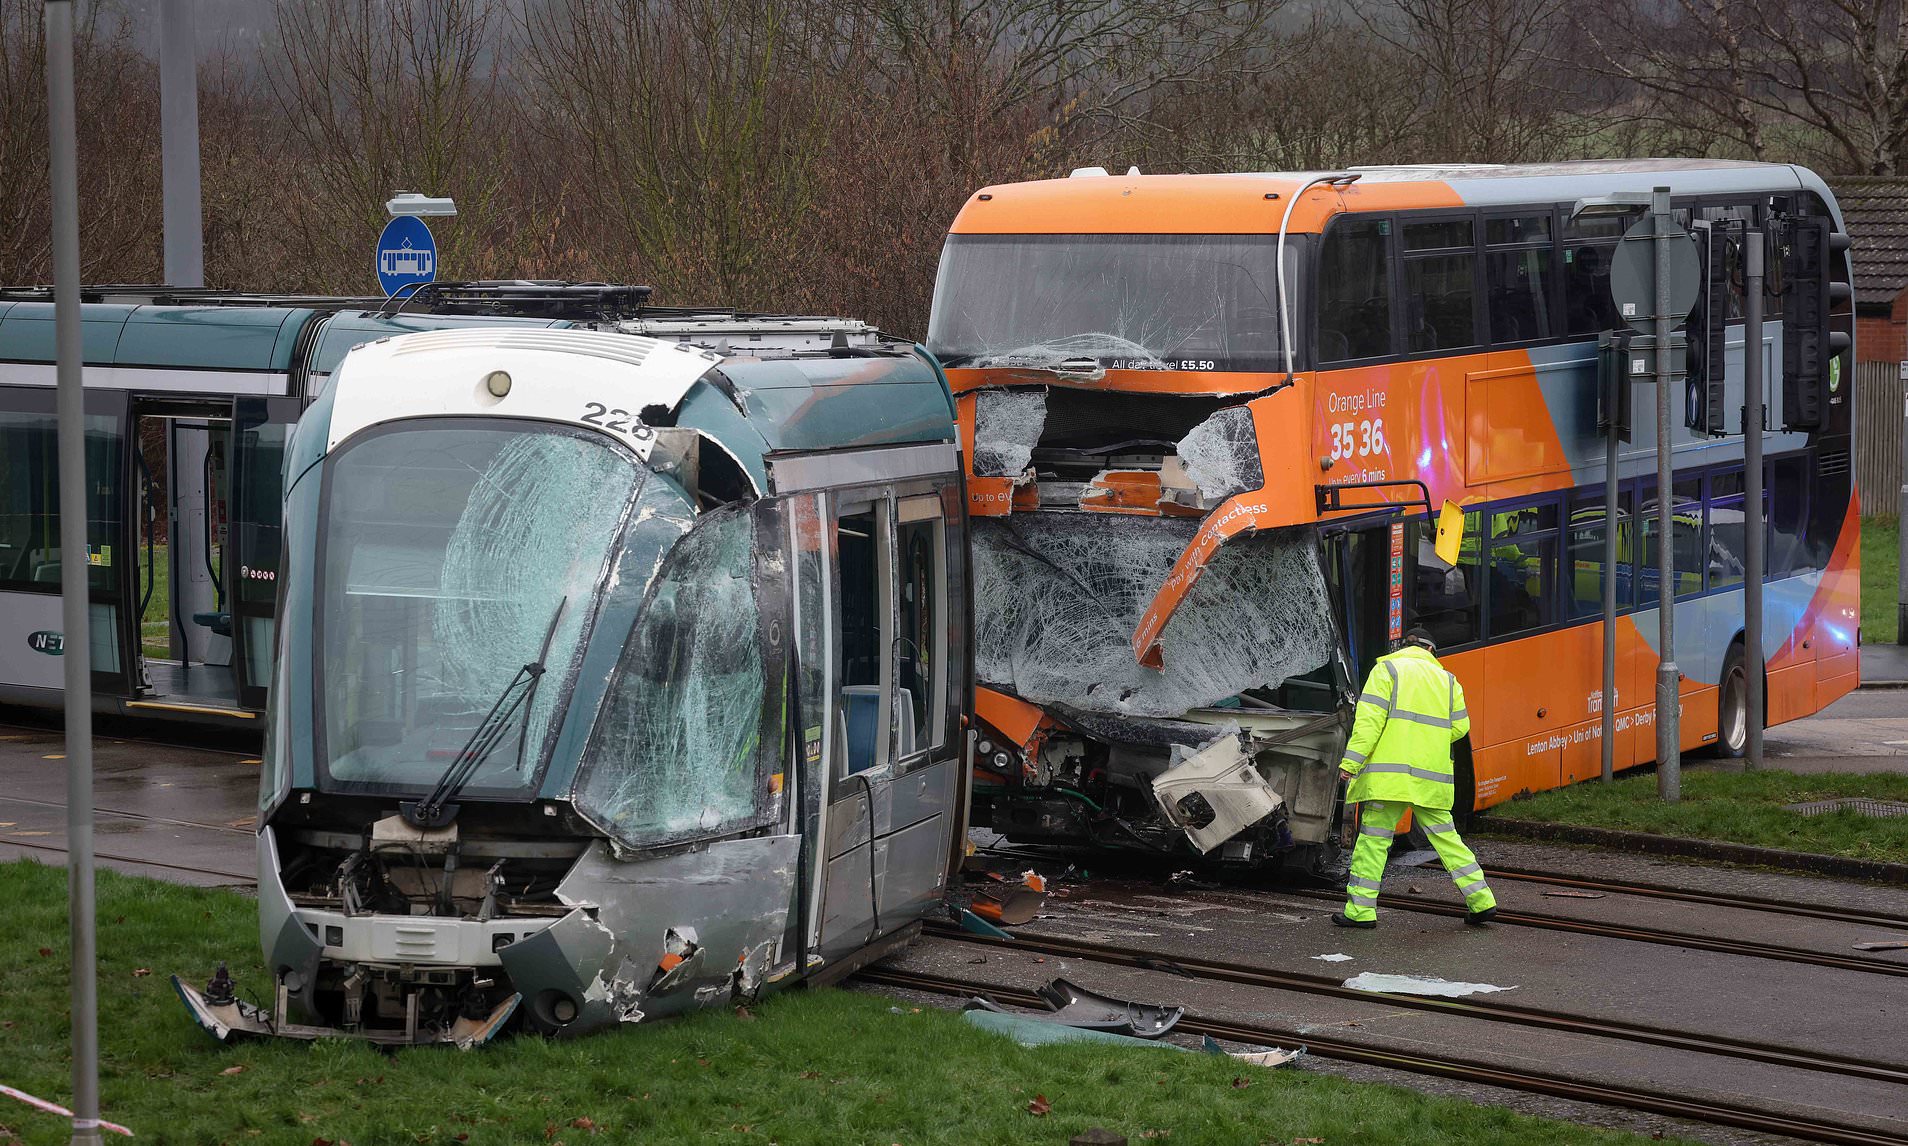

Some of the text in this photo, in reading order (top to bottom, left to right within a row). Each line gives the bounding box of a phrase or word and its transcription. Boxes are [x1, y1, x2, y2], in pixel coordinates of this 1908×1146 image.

[1111, 359, 1126, 369] All
[1181, 360, 1215, 370] £5.50
[1328, 388, 1386, 416] Orange Line
[580, 402, 654, 441] 228
[1330, 418, 1384, 461] 35 36
[1343, 473, 1361, 484] every
[1362, 468, 1367, 483] 6
[1368, 466, 1386, 482] mins
[986, 493, 995, 502] to
[1141, 613, 1158, 640] mins
[1184, 544, 1202, 571] with
[1201, 503, 1268, 546] Contactless
[35, 634, 65, 650] NET
[1527, 741, 1548, 756] Lenton
[1548, 735, 1568, 750] Abbey
[1573, 729, 1585, 744] Uni
[1585, 728, 1592, 740] of
[1592, 724, 1603, 739] Not
[1615, 715, 1630, 733] QMC
[1635, 711, 1652, 727] Derby
